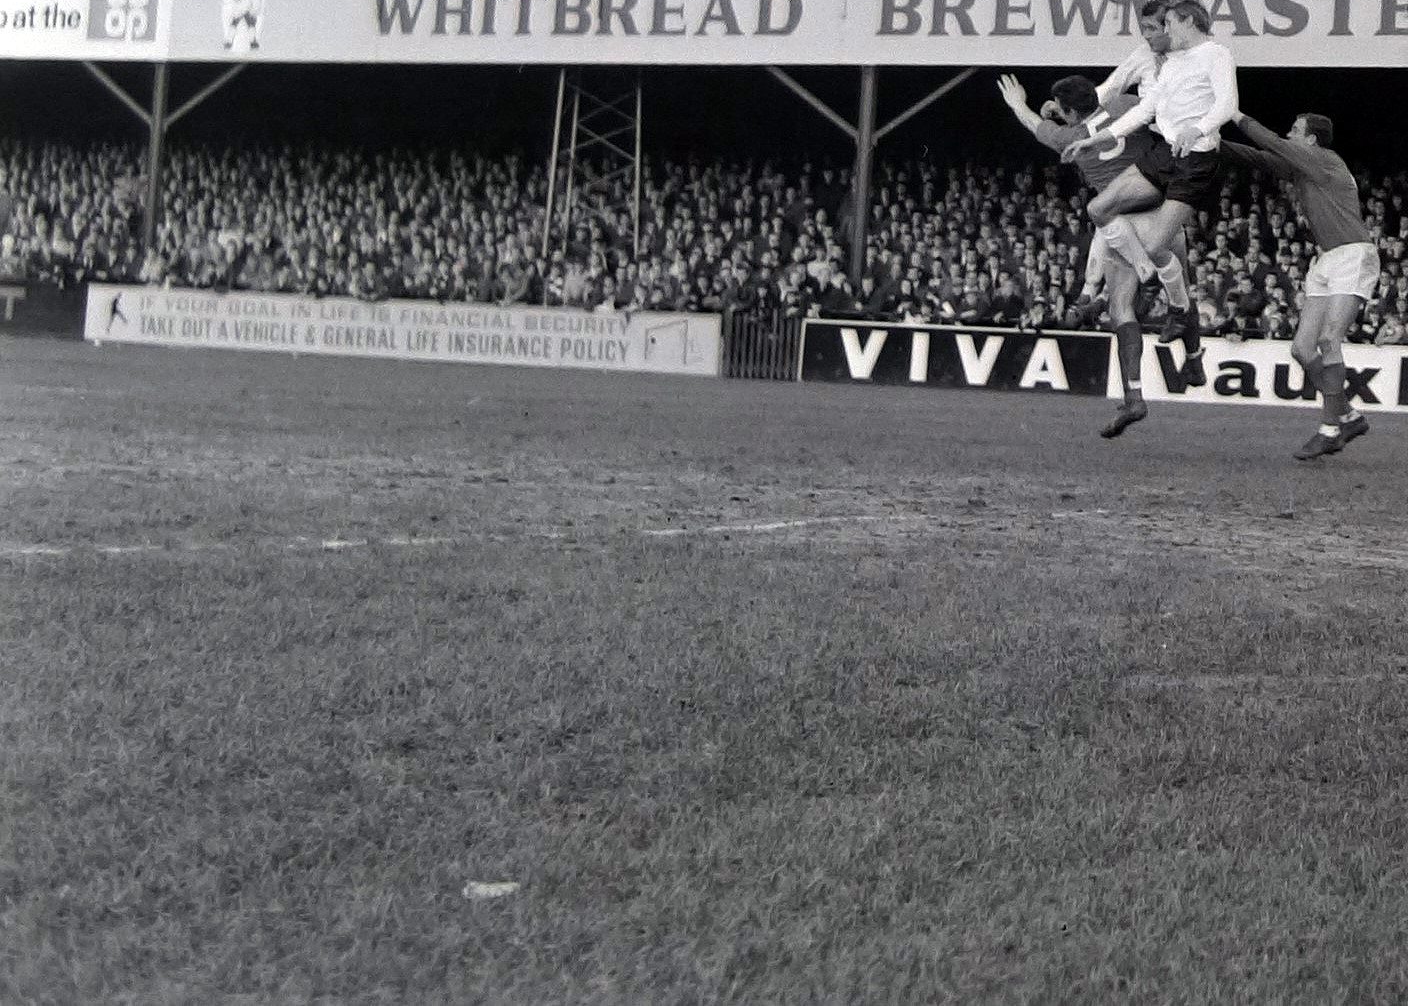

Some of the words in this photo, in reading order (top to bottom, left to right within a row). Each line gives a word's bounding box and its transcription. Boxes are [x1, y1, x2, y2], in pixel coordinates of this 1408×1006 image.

[12, 5, 36, 29] at
[43, 2, 82, 29] the
[139, 314, 177, 337] TAKE
[182, 317, 213, 339] OUT
[218, 320, 229, 340] A
[233, 321, 299, 344] VEHICLE
[322, 325, 398, 350] GENERAL
[407, 330, 440, 353] LIFE
[447, 332, 553, 359] INSURANCE
[560, 337, 629, 362] POLICY
[400, 309, 515, 330] FINANCIAL
[840, 328, 1070, 390] VIVA
